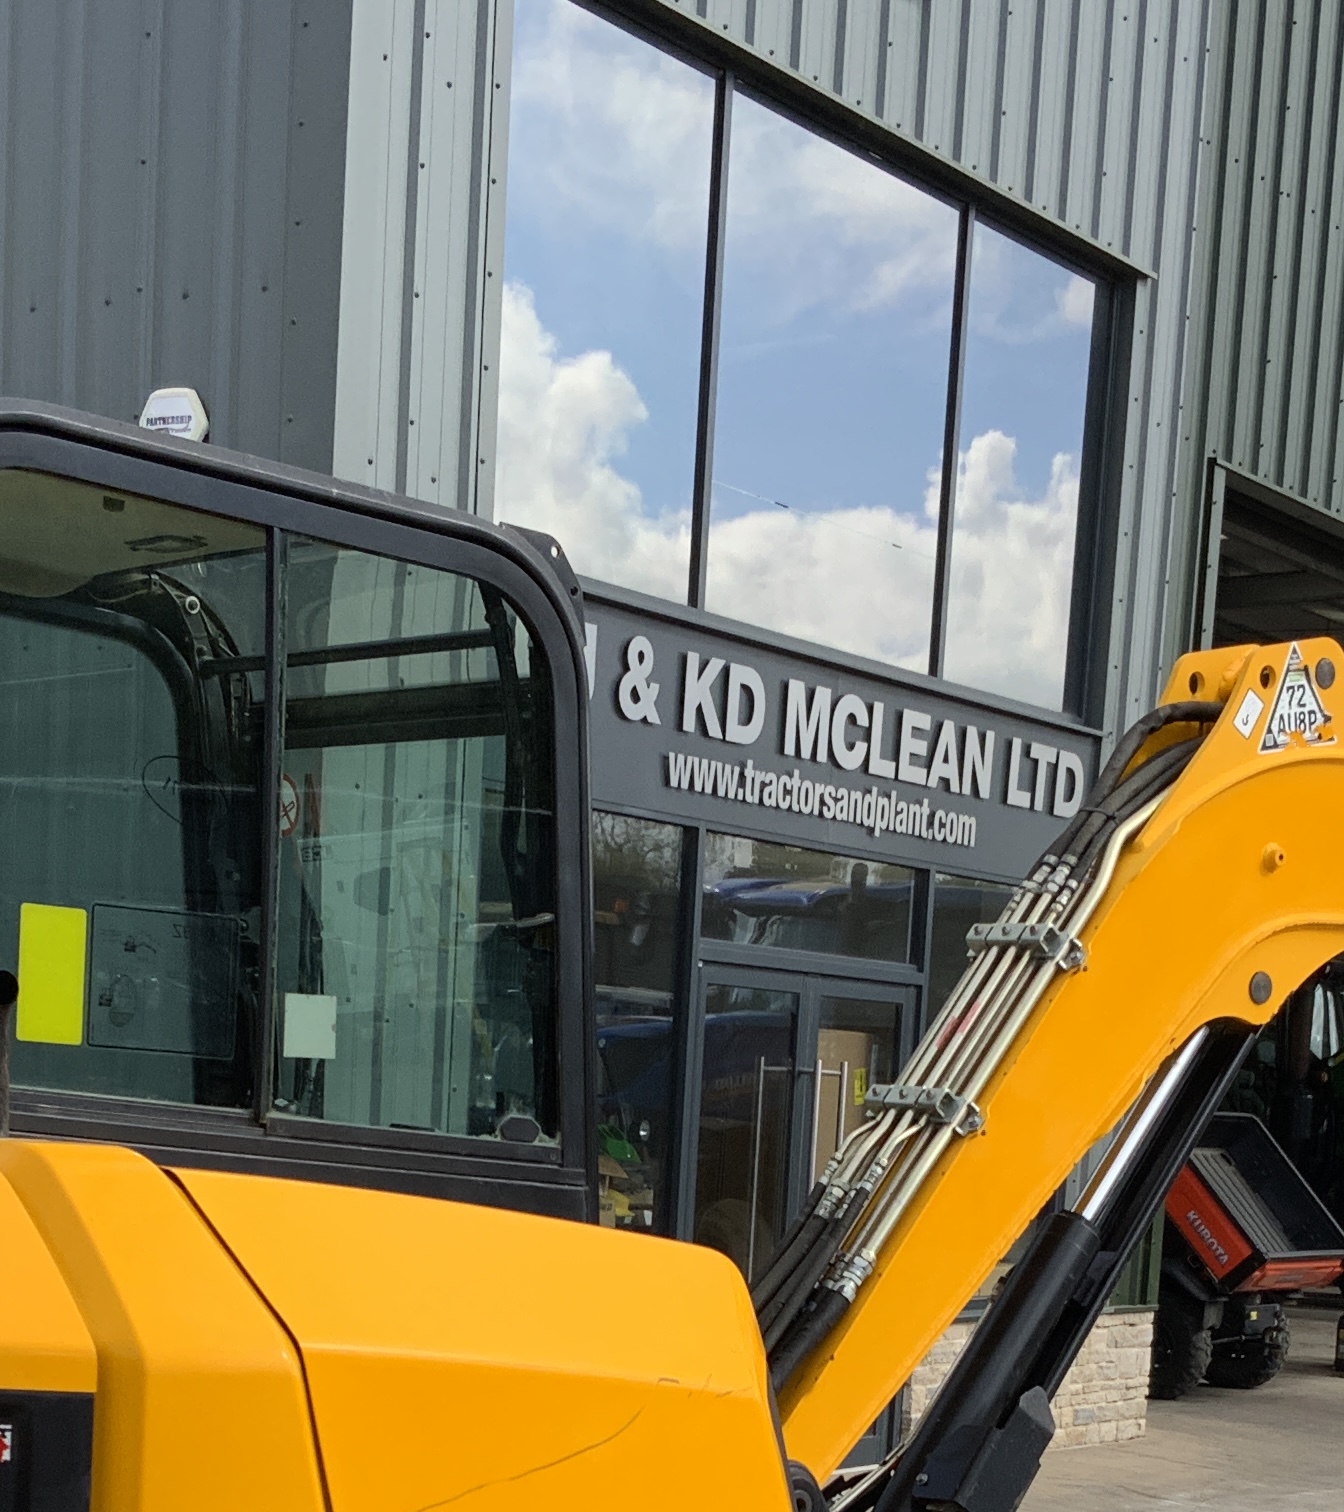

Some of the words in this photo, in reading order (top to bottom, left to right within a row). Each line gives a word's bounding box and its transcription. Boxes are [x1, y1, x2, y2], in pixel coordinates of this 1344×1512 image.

[146, 415, 192, 426] PARTNERSHIP
[1286, 684, 1307, 711] 72
[618, 635, 662, 725] &
[682, 650, 766, 745] KD
[783, 678, 995, 799] MCLEAN
[1006, 736, 1085, 819] LTD
[668, 751, 977, 848] www.tractorsandplant.com
[1186, 1210, 1229, 1266] KUBOTA
